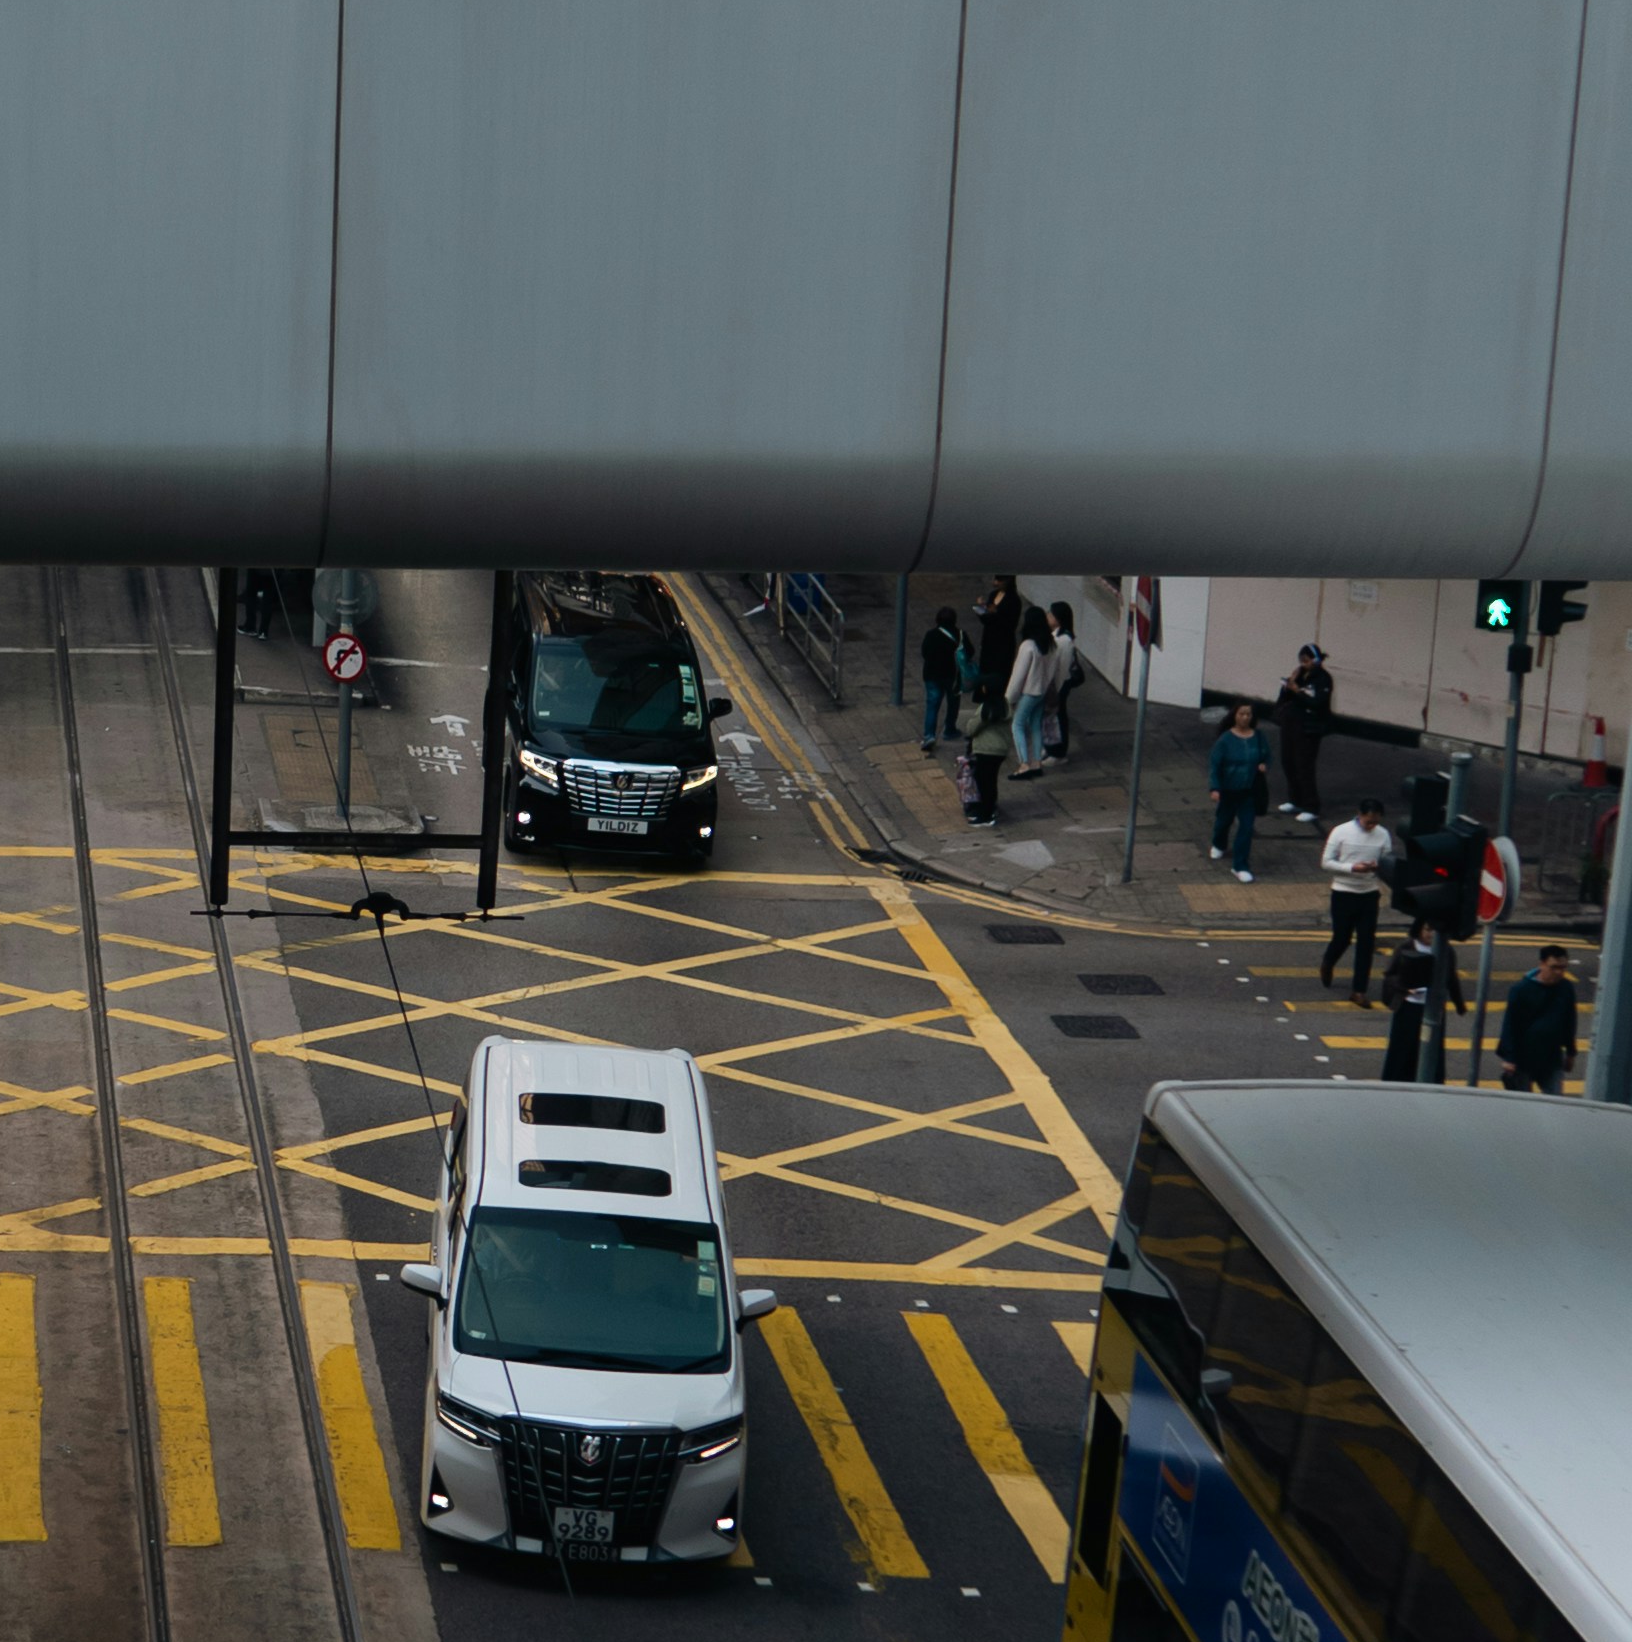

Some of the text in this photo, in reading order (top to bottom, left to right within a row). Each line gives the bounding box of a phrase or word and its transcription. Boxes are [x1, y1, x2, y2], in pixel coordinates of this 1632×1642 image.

[596, 819, 639, 833] YILDIZ
[573, 1510, 598, 1526] VG
[558, 1523, 609, 1541] 9289
